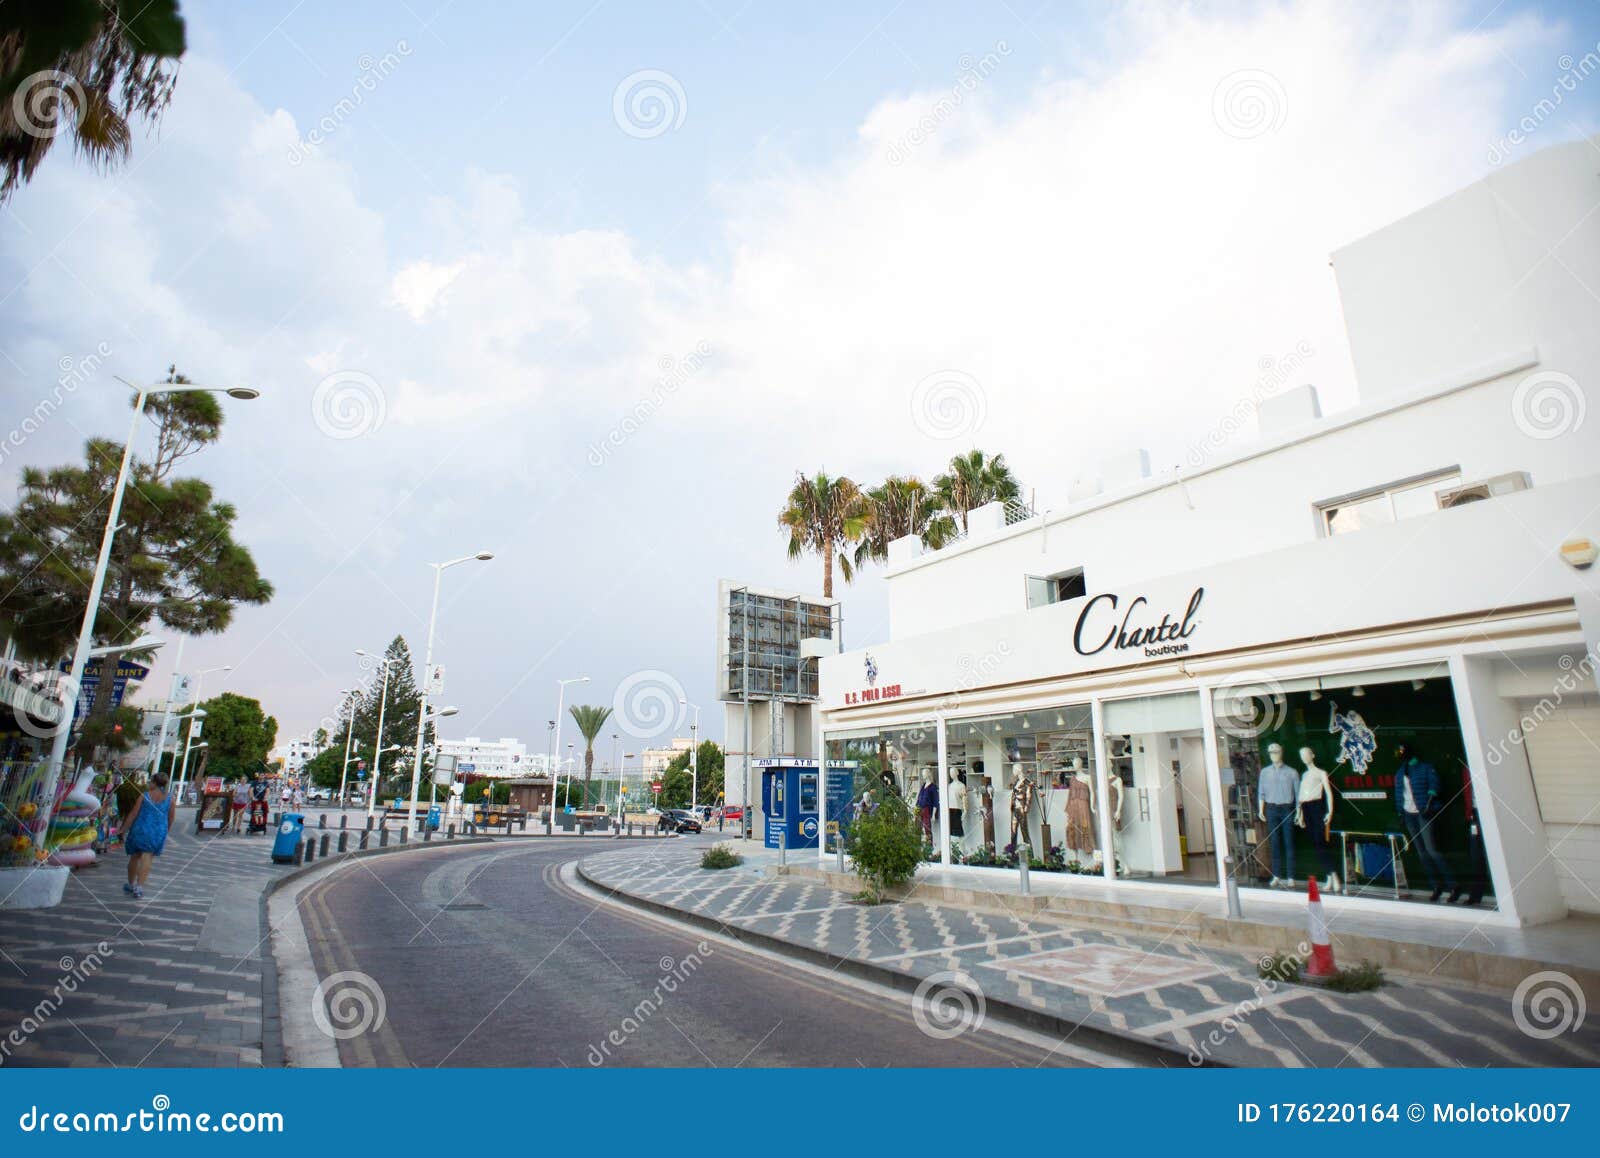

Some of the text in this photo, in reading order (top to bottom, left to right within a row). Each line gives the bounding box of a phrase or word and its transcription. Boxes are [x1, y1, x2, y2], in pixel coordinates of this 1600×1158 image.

[1073, 587, 1204, 656] Chantel
[1145, 643, 1189, 656] boutique
[114, 668, 143, 676] RINT
[861, 688, 879, 702] POLO
